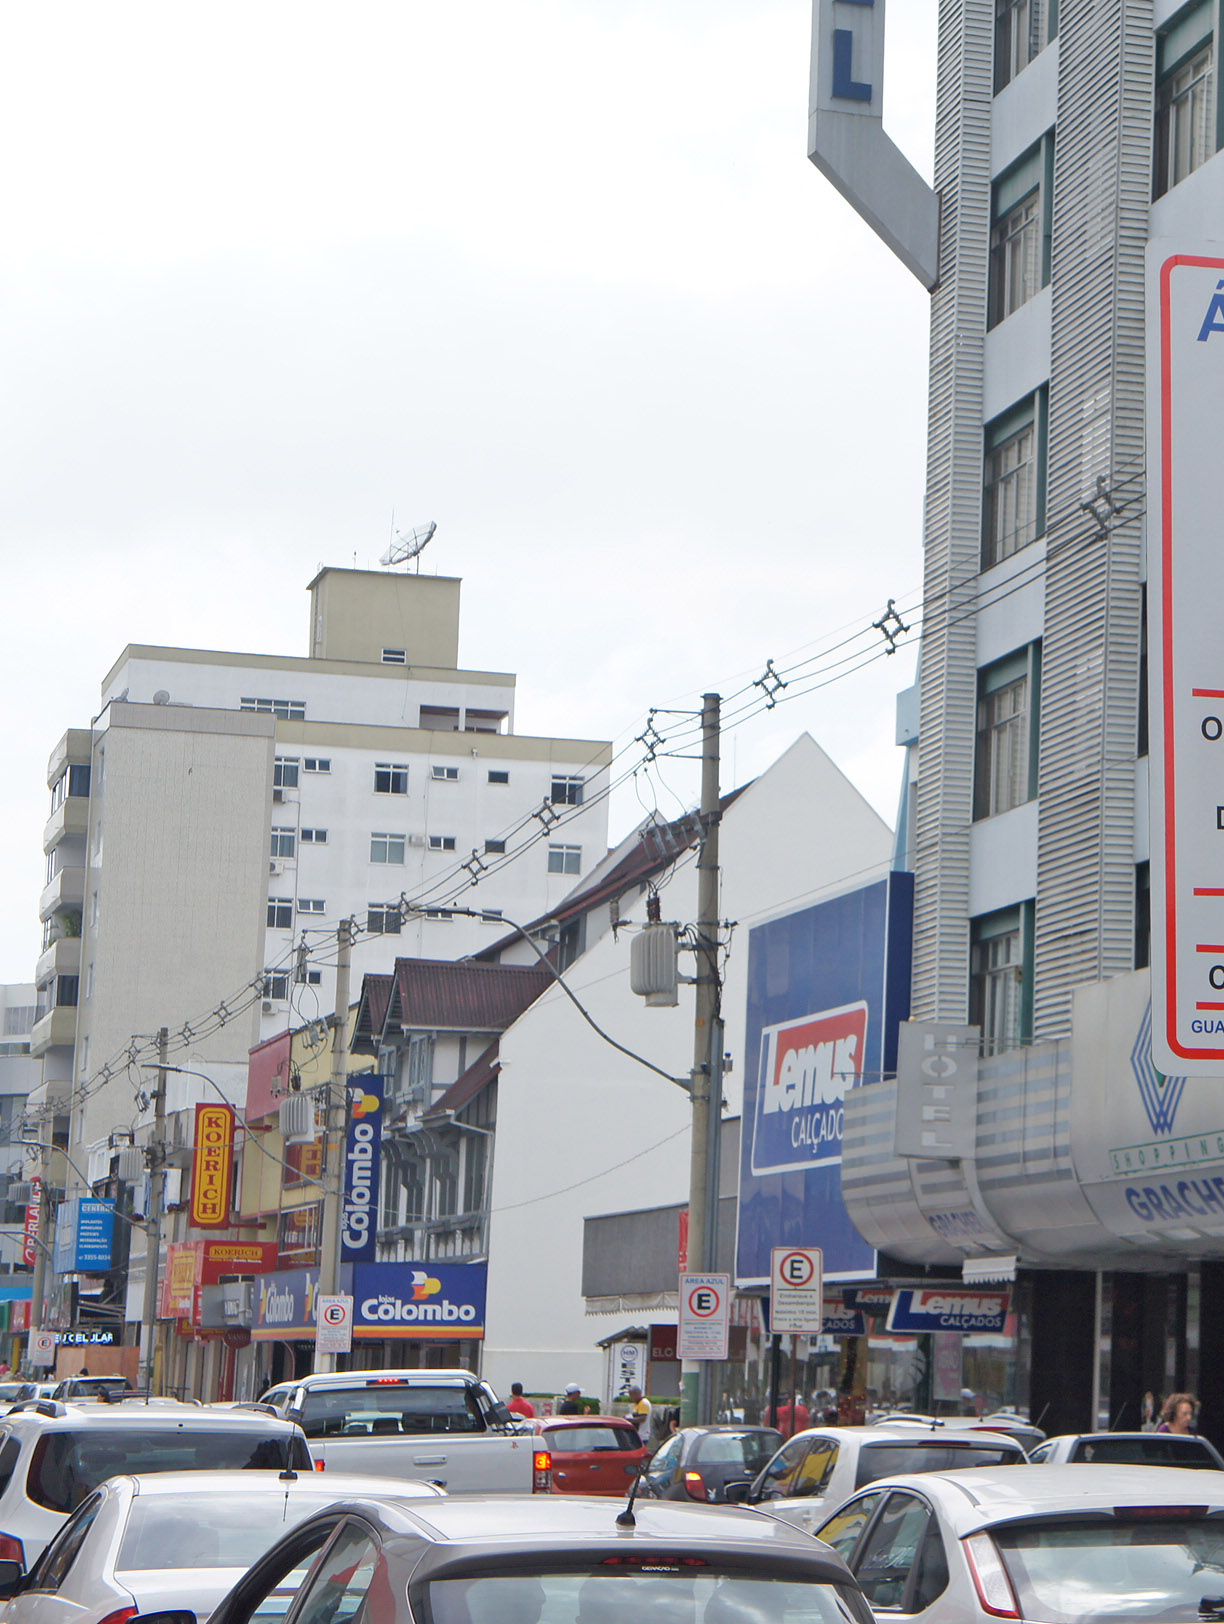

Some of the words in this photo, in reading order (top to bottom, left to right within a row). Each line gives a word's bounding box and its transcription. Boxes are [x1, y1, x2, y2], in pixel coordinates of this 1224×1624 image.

[763, 1027, 859, 1115] Lemus
[920, 1033, 958, 1148] HOTEL
[791, 1107, 845, 1153] CALÇADO
[1113, 1136, 1224, 1170] SHOPPING
[201, 1116, 224, 1215] KOERICH
[342, 1123, 374, 1250] Colombo
[213, 1248, 260, 1257] KOERICH
[789, 1259, 804, 1280] E
[378, 1294, 396, 1305] lojas
[697, 1293, 711, 1310] E
[855, 1289, 892, 1304] Lem
[909, 1290, 1002, 1314] Lemus
[330, 1308, 341, 1320] E
[361, 1299, 476, 1321] Colombo
[940, 1315, 1002, 1328] CALÇADOS
